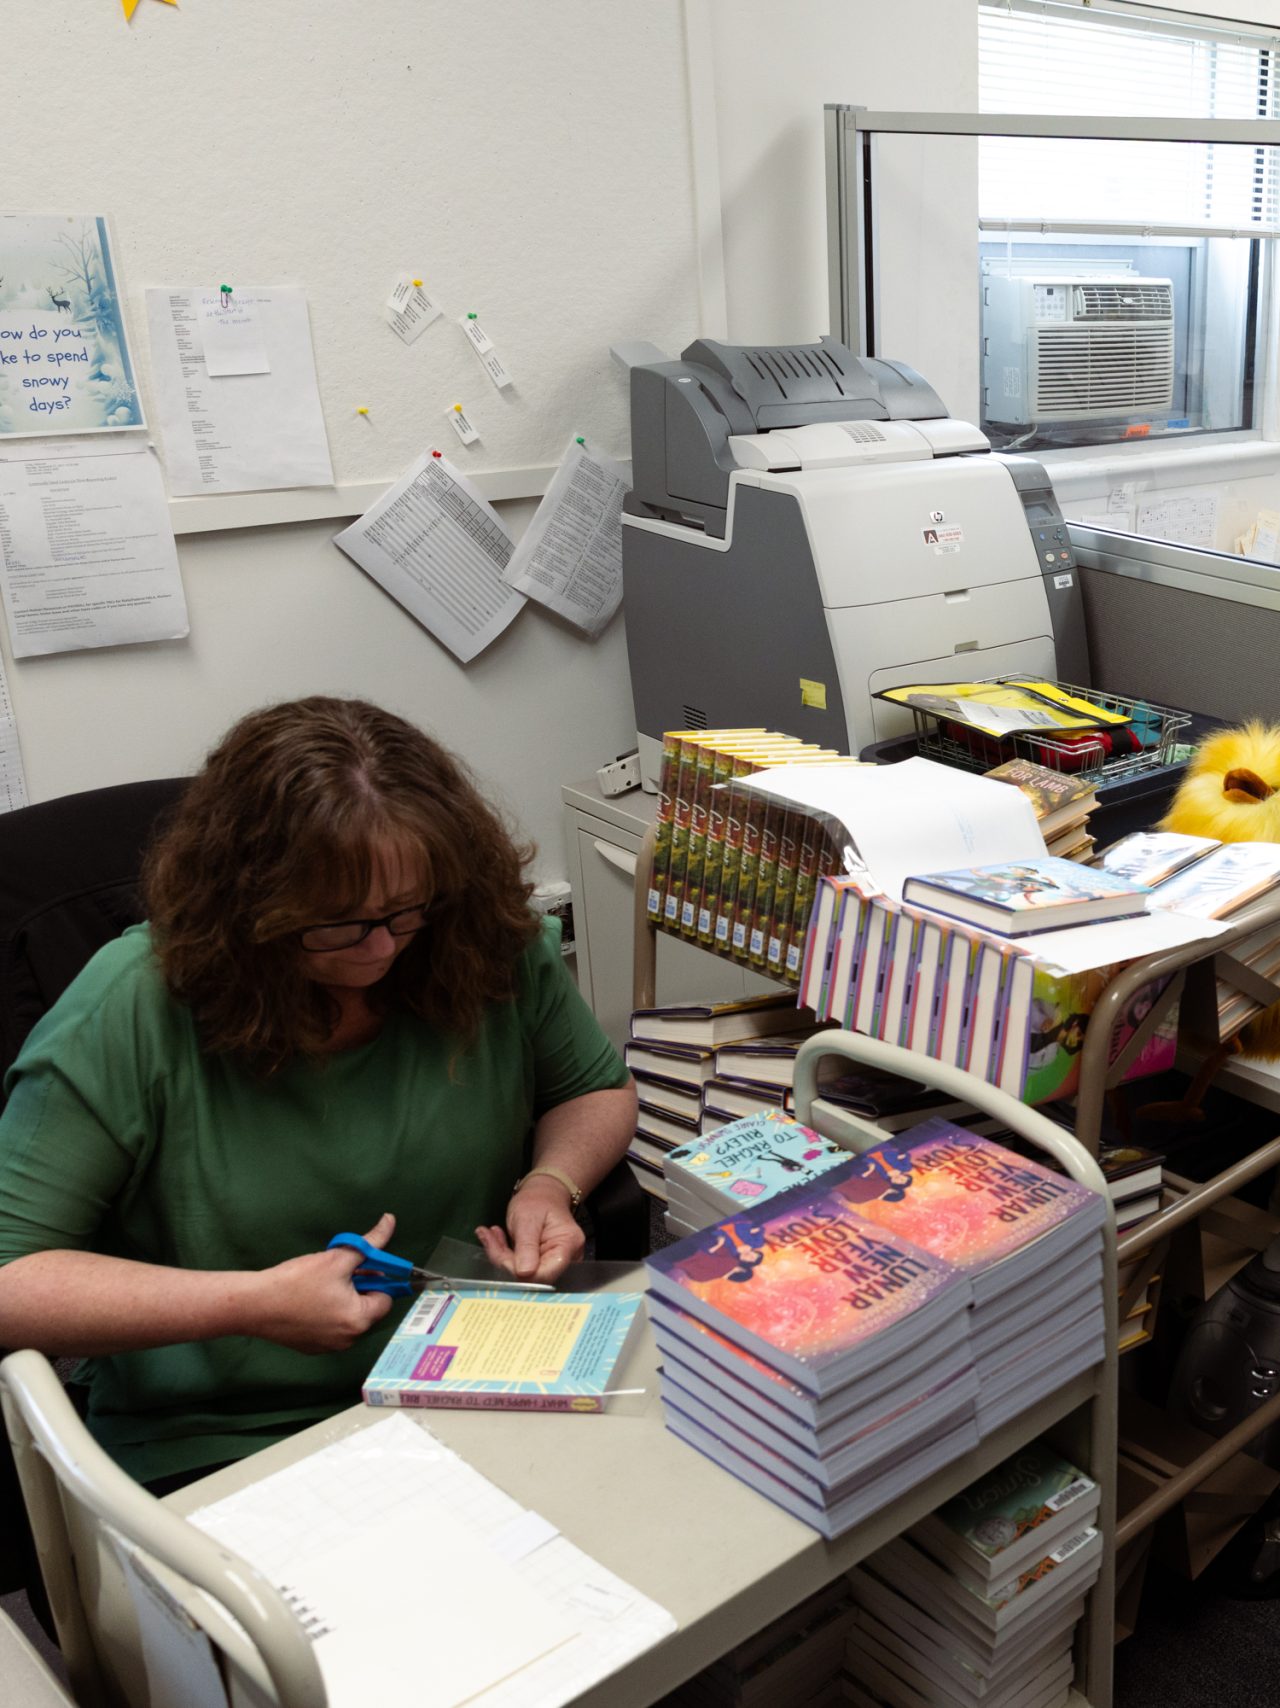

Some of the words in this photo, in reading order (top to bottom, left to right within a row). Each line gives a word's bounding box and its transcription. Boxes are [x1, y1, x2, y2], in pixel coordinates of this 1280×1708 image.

[0, 330, 23, 340] ow
[29, 324, 48, 340] do
[52, 328, 82, 343] you
[0, 350, 18, 365] ke
[23, 349, 41, 365] to
[47, 346, 89, 368] spend
[22, 376, 69, 391] snowy
[29, 395, 72, 415] days?
[1007, 768, 1033, 782] FOR
[1029, 777, 1070, 794] LAMB
[735, 1120, 766, 1131] CLAIRE
[773, 1131, 797, 1144] TO
[713, 1140, 772, 1169] RACHEL
[716, 1128, 765, 1156] RILEY?
[910, 1139, 977, 1177] STORY
[938, 1148, 999, 1179] LOVE
[955, 1160, 1022, 1193] YEAR
[987, 1167, 1044, 1202] NEW
[987, 1180, 1068, 1224] LUNAR
[764, 1209, 837, 1255] STORY
[792, 1219, 860, 1256] LOVE
[808, 1233, 882, 1275] YEAR
[841, 1244, 905, 1286] NEW
[840, 1257, 929, 1311] LUNAR
[424, 1395, 463, 1406] RACHEL
[465, 1396, 479, 1406] TO
[483, 1397, 538, 1408] HAPPENED
[542, 1399, 568, 1409] WHAT
[966, 1455, 1042, 1511] Simon
